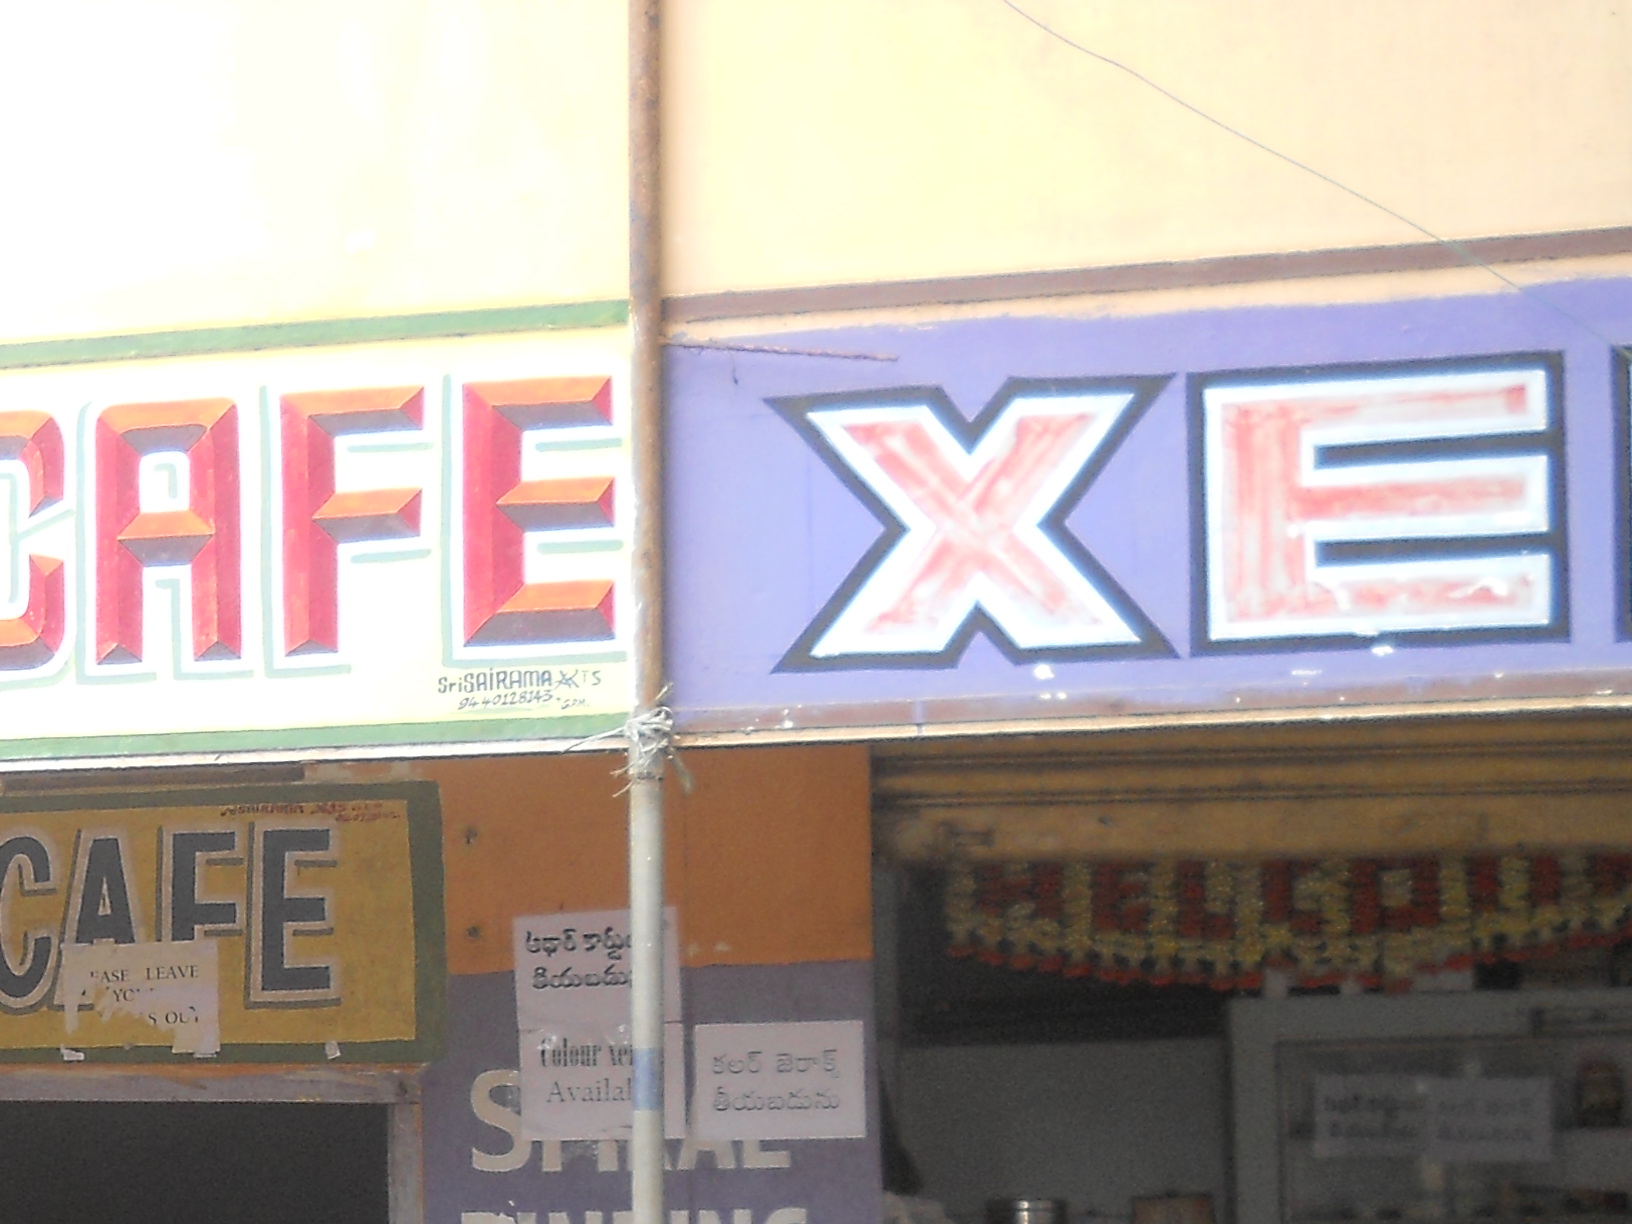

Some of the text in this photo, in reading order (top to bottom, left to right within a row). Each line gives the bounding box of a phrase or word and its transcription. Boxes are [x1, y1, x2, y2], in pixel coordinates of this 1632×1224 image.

[763, 345, 1632, 675] XE
[146, 965, 200, 981] LEAVE
[546, 1077, 633, 1103] Availa
